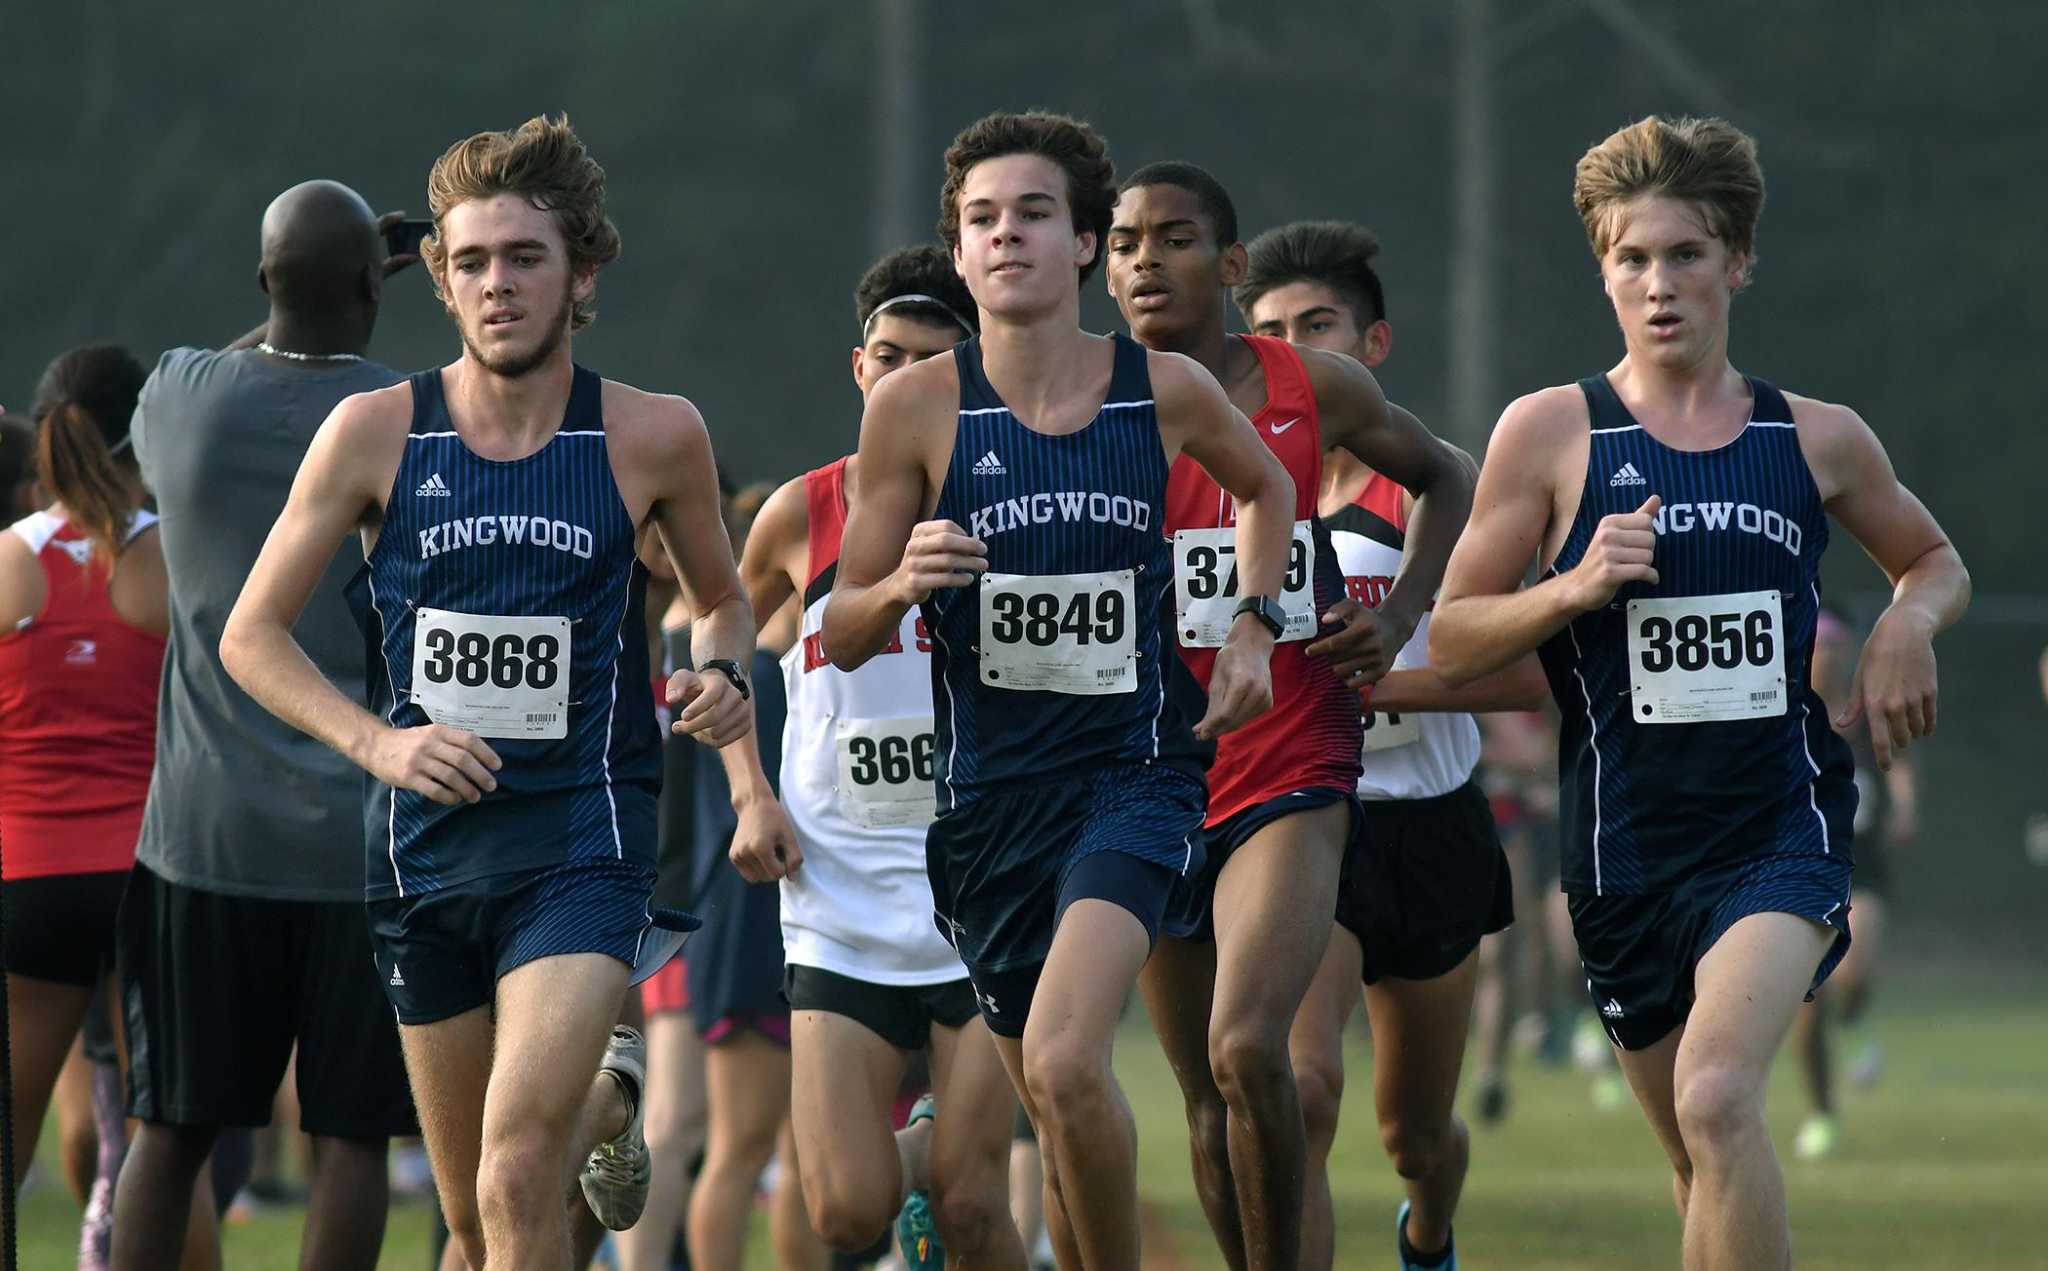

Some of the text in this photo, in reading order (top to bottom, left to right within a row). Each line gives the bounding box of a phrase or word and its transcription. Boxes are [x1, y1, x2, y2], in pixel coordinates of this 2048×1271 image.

[415, 487, 451, 497] adidas
[972, 465, 1007, 475] adidas
[1610, 476, 1647, 487] adidas
[419, 515, 593, 560] KINGWOOD
[970, 492, 1150, 540] KINGWOOD
[1652, 502, 1802, 556] NGWOOD
[1186, 539, 1307, 599] 379
[992, 589, 1125, 646] 3849
[1640, 609, 1774, 673] 3856
[424, 628, 559, 690] 3868
[849, 733, 935, 785] 366
